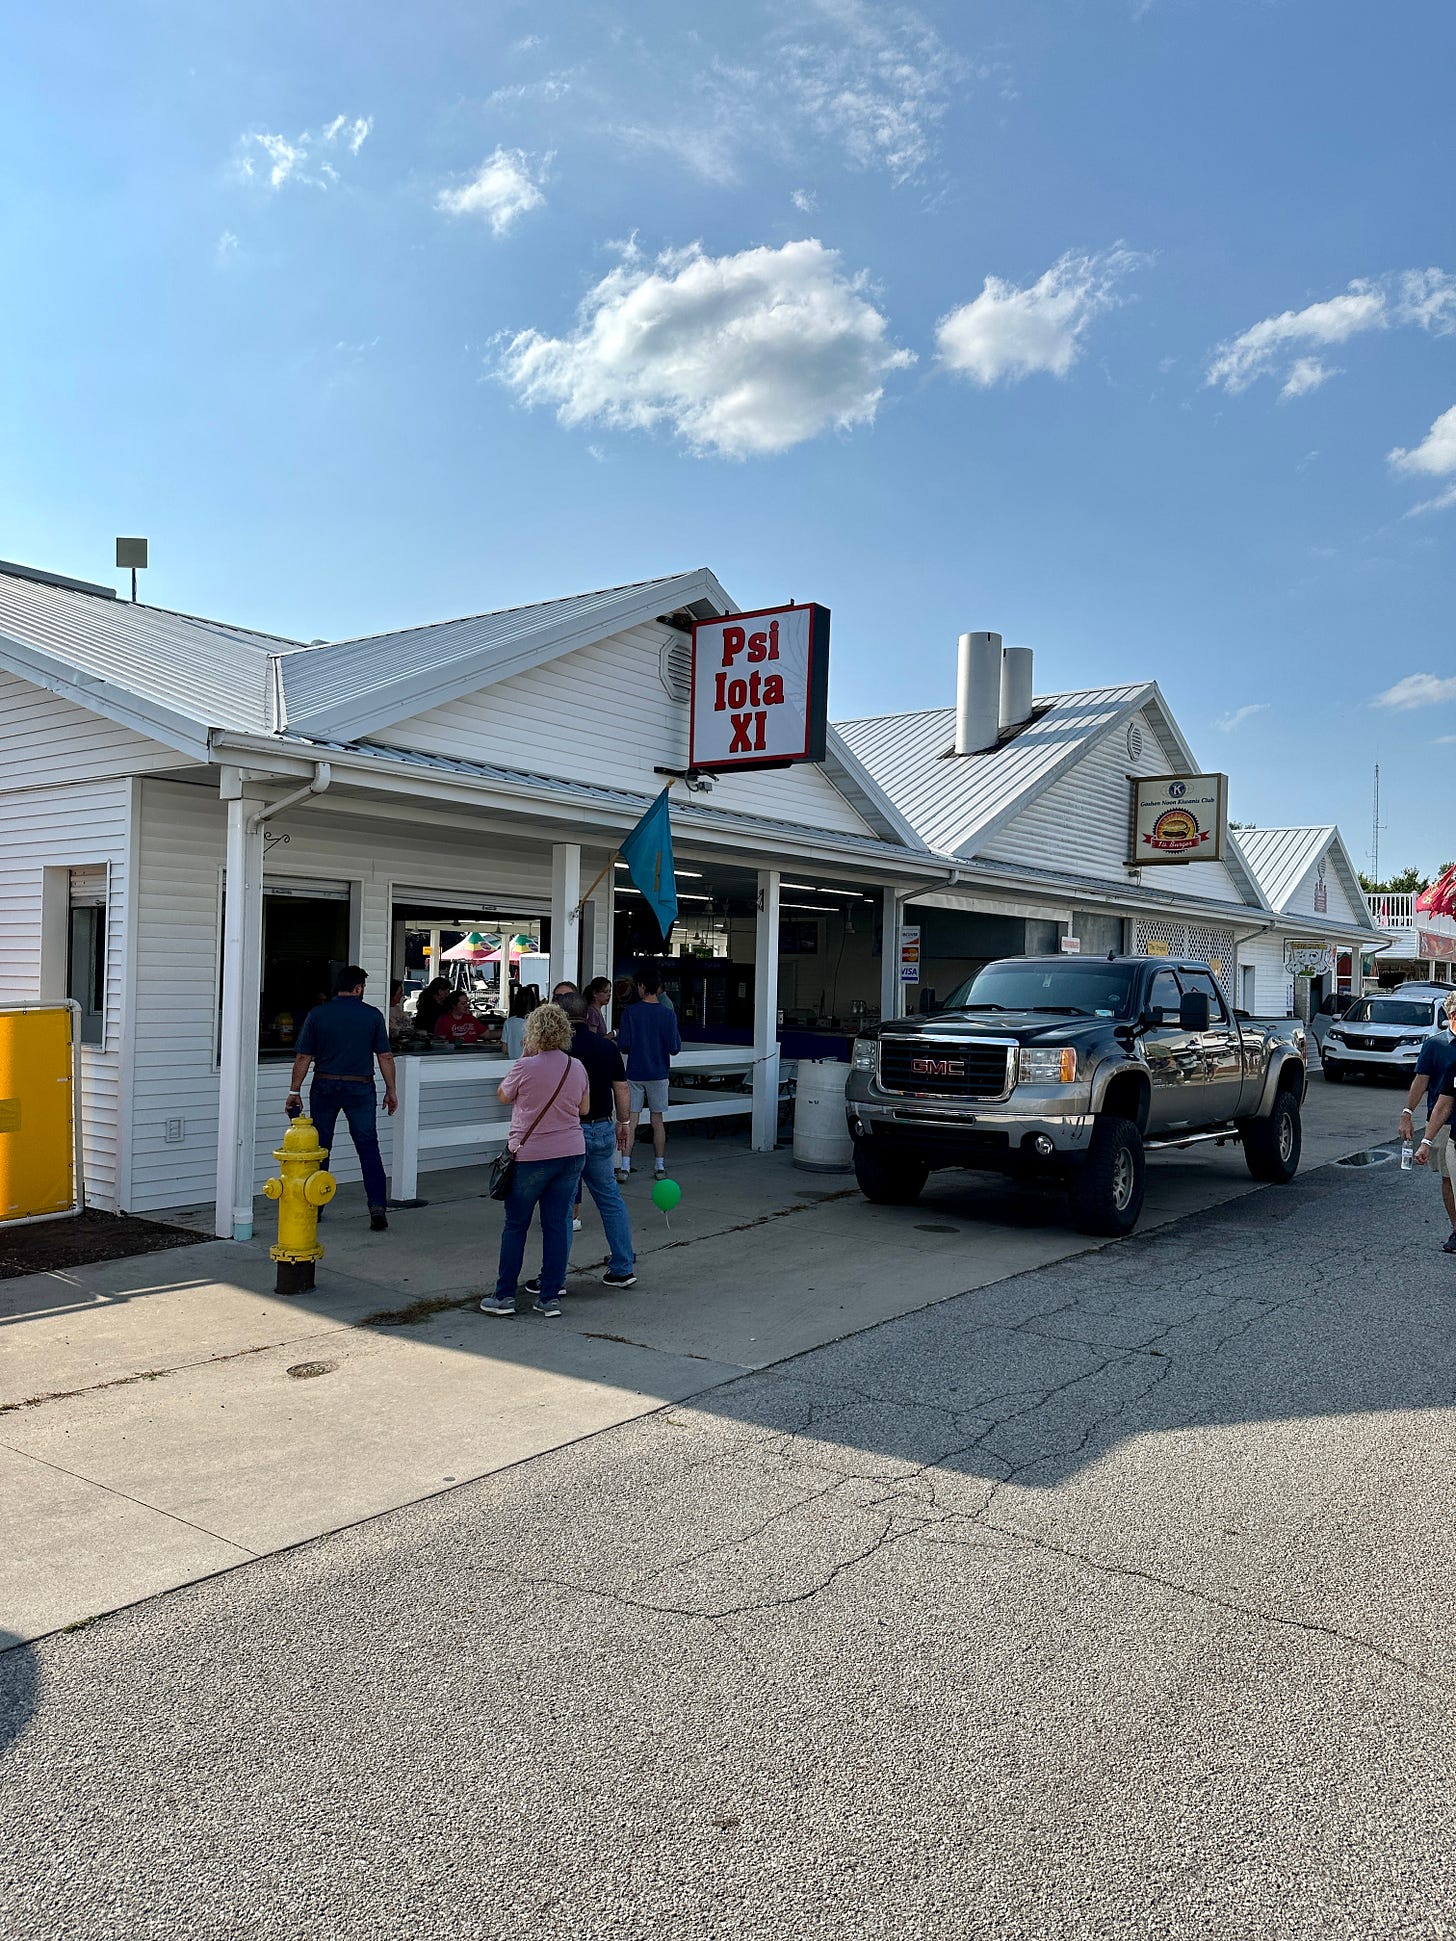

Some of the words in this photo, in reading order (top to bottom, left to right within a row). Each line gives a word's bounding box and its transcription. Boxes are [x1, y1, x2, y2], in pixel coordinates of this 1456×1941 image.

[721, 620, 780, 668] Psi
[714, 670, 785, 712] Iota
[729, 711, 767, 754] XI
[911, 1058, 965, 1076] GMC
